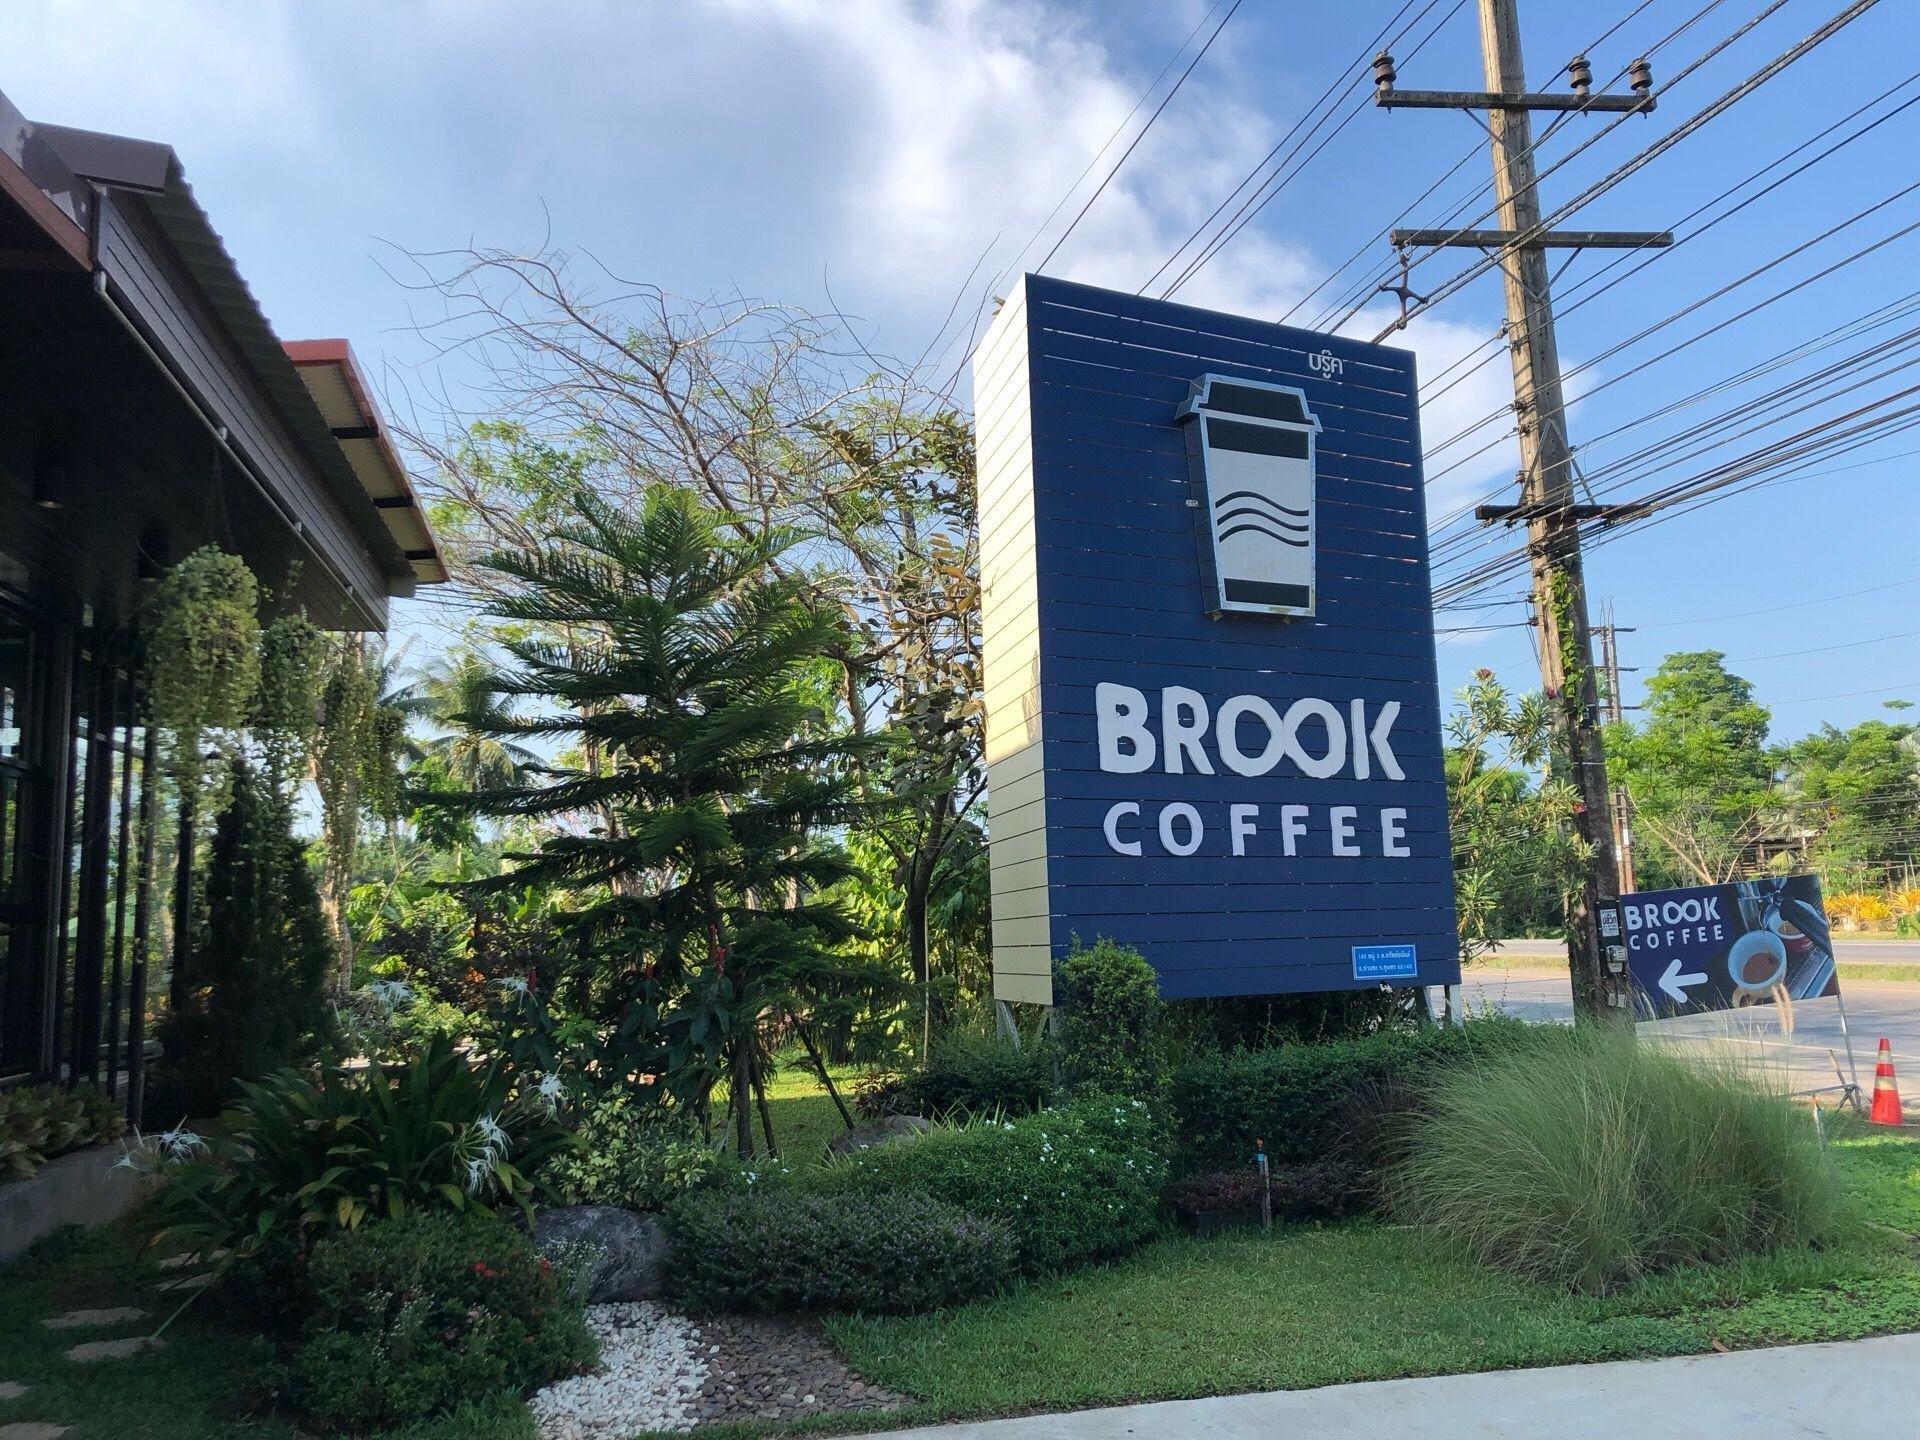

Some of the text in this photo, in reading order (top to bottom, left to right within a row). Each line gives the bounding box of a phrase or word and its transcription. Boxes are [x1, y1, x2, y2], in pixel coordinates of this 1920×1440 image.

[1095, 682, 1406, 781] BROOK
[1103, 801, 1411, 858] COFFEE
[1624, 896, 1721, 931] BROOK
[1629, 924, 1724, 950] COFFEE
